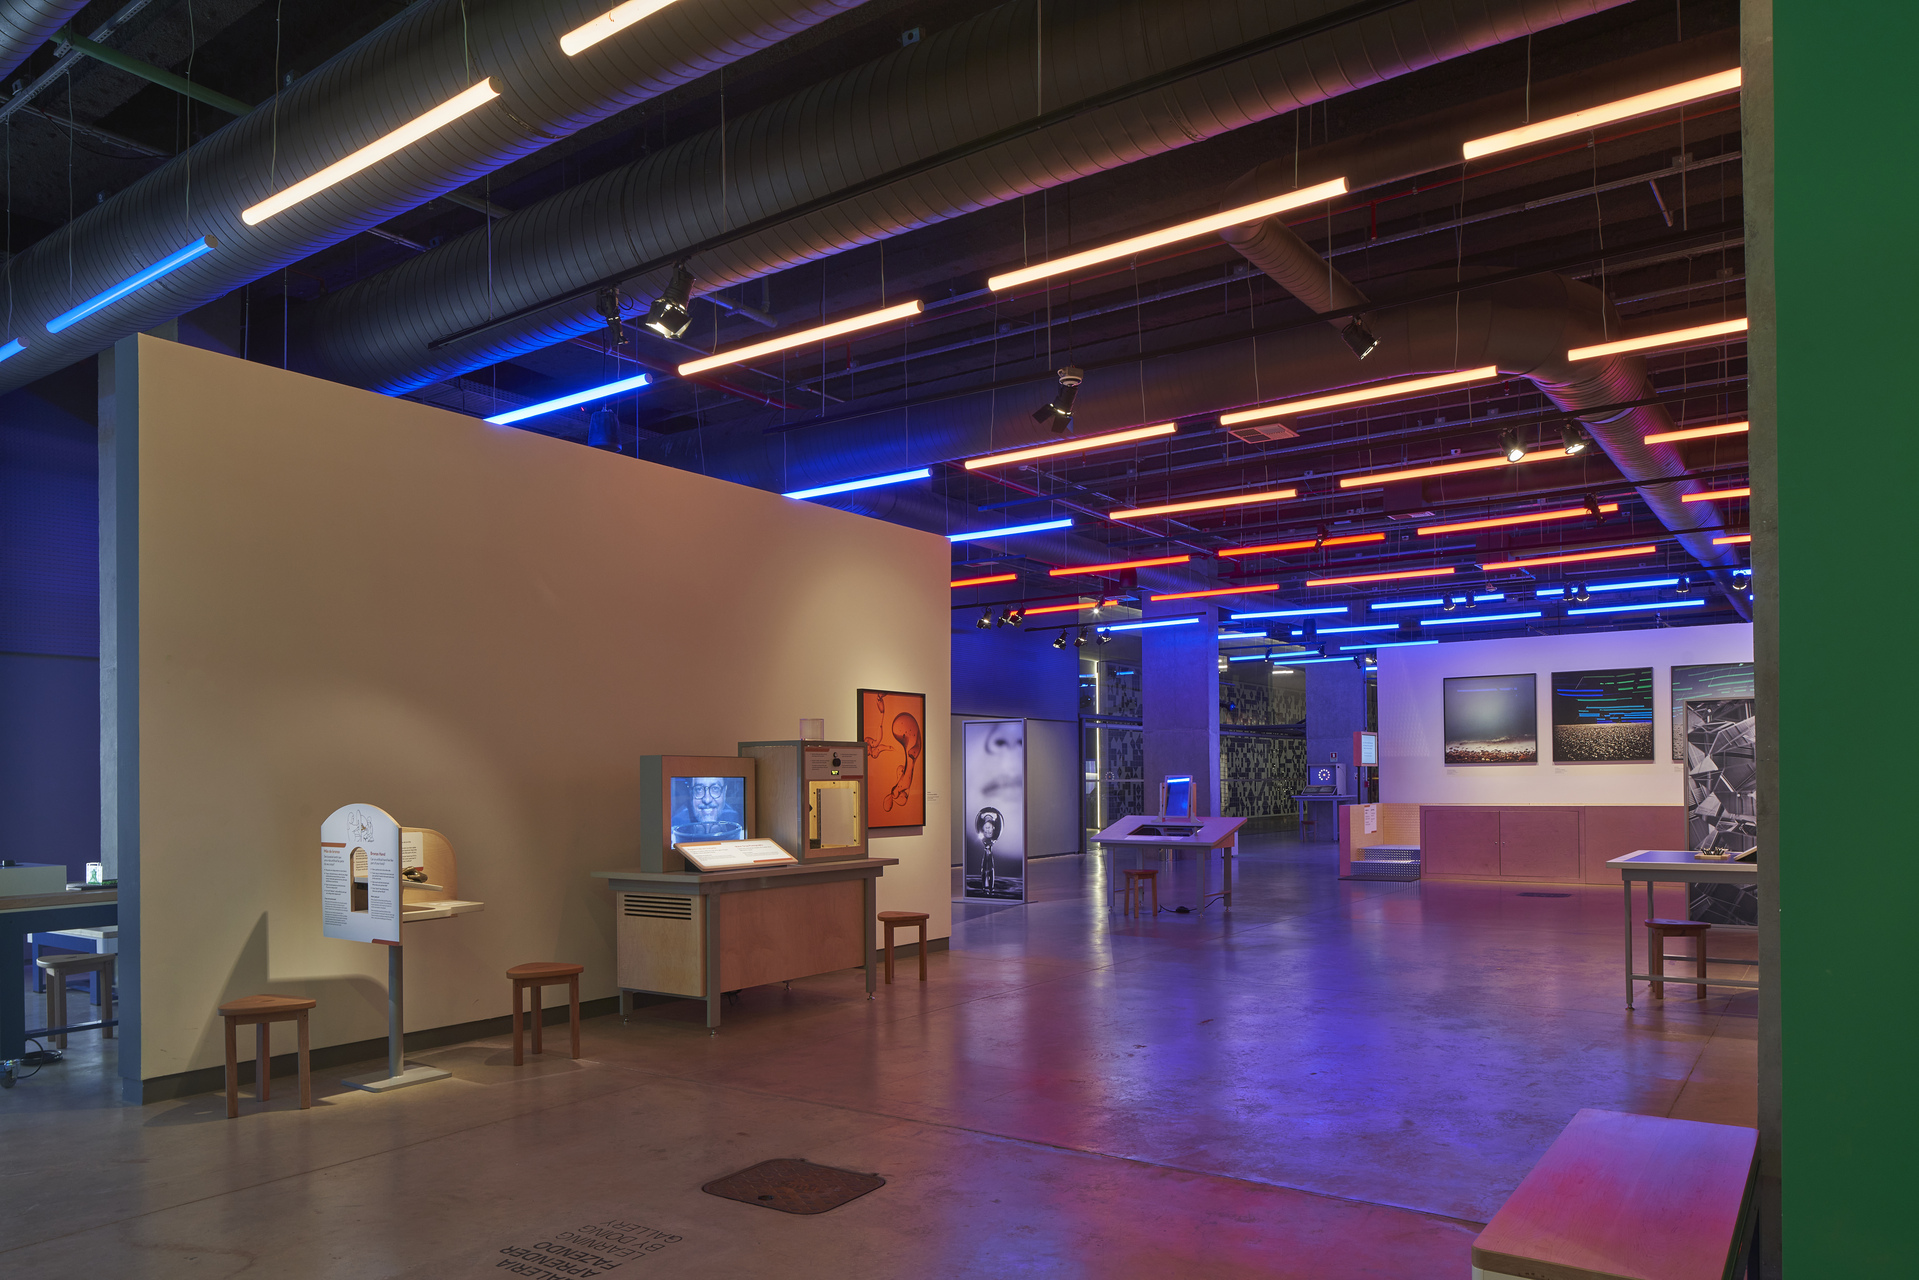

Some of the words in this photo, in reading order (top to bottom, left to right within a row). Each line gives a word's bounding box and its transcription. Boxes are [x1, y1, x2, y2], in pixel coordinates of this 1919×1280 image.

[577, 1224, 638, 1245] DOING
[601, 1219, 684, 1244] GALLERY
[533, 1241, 623, 1271] FAZENDO
[555, 1231, 646, 1261] LEARNING
[632, 1240, 666, 1253] BY
[496, 1259, 573, 1280] ALERIA
[500, 1245, 602, 1278] APRENDER
